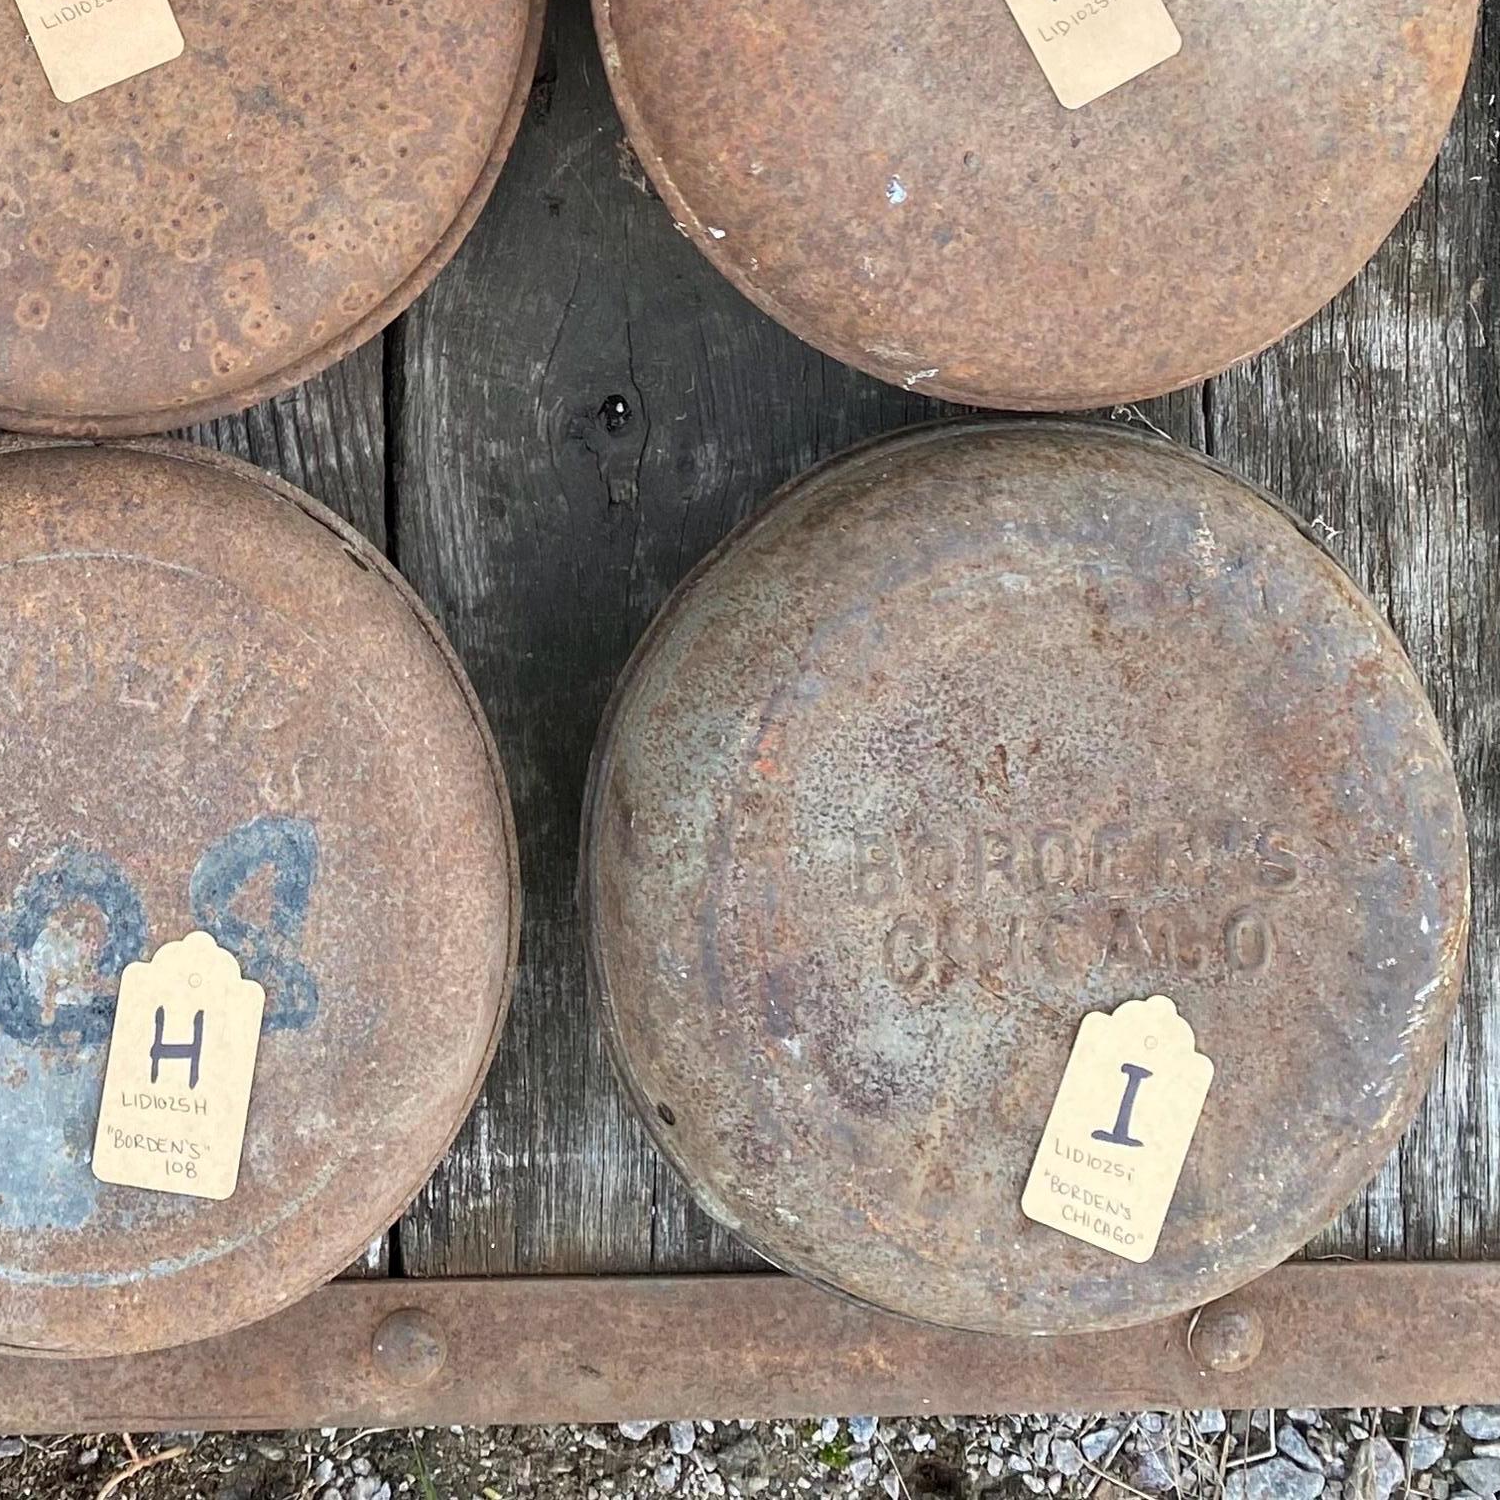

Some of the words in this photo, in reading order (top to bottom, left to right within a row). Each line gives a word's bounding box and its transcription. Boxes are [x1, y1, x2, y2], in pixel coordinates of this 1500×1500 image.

[150, 1005, 205, 1090] H
[1090, 1063, 1154, 1148] I
[106, 1125, 211, 1160] "BORDEN'S"
[165, 1160, 198, 1179] 108
